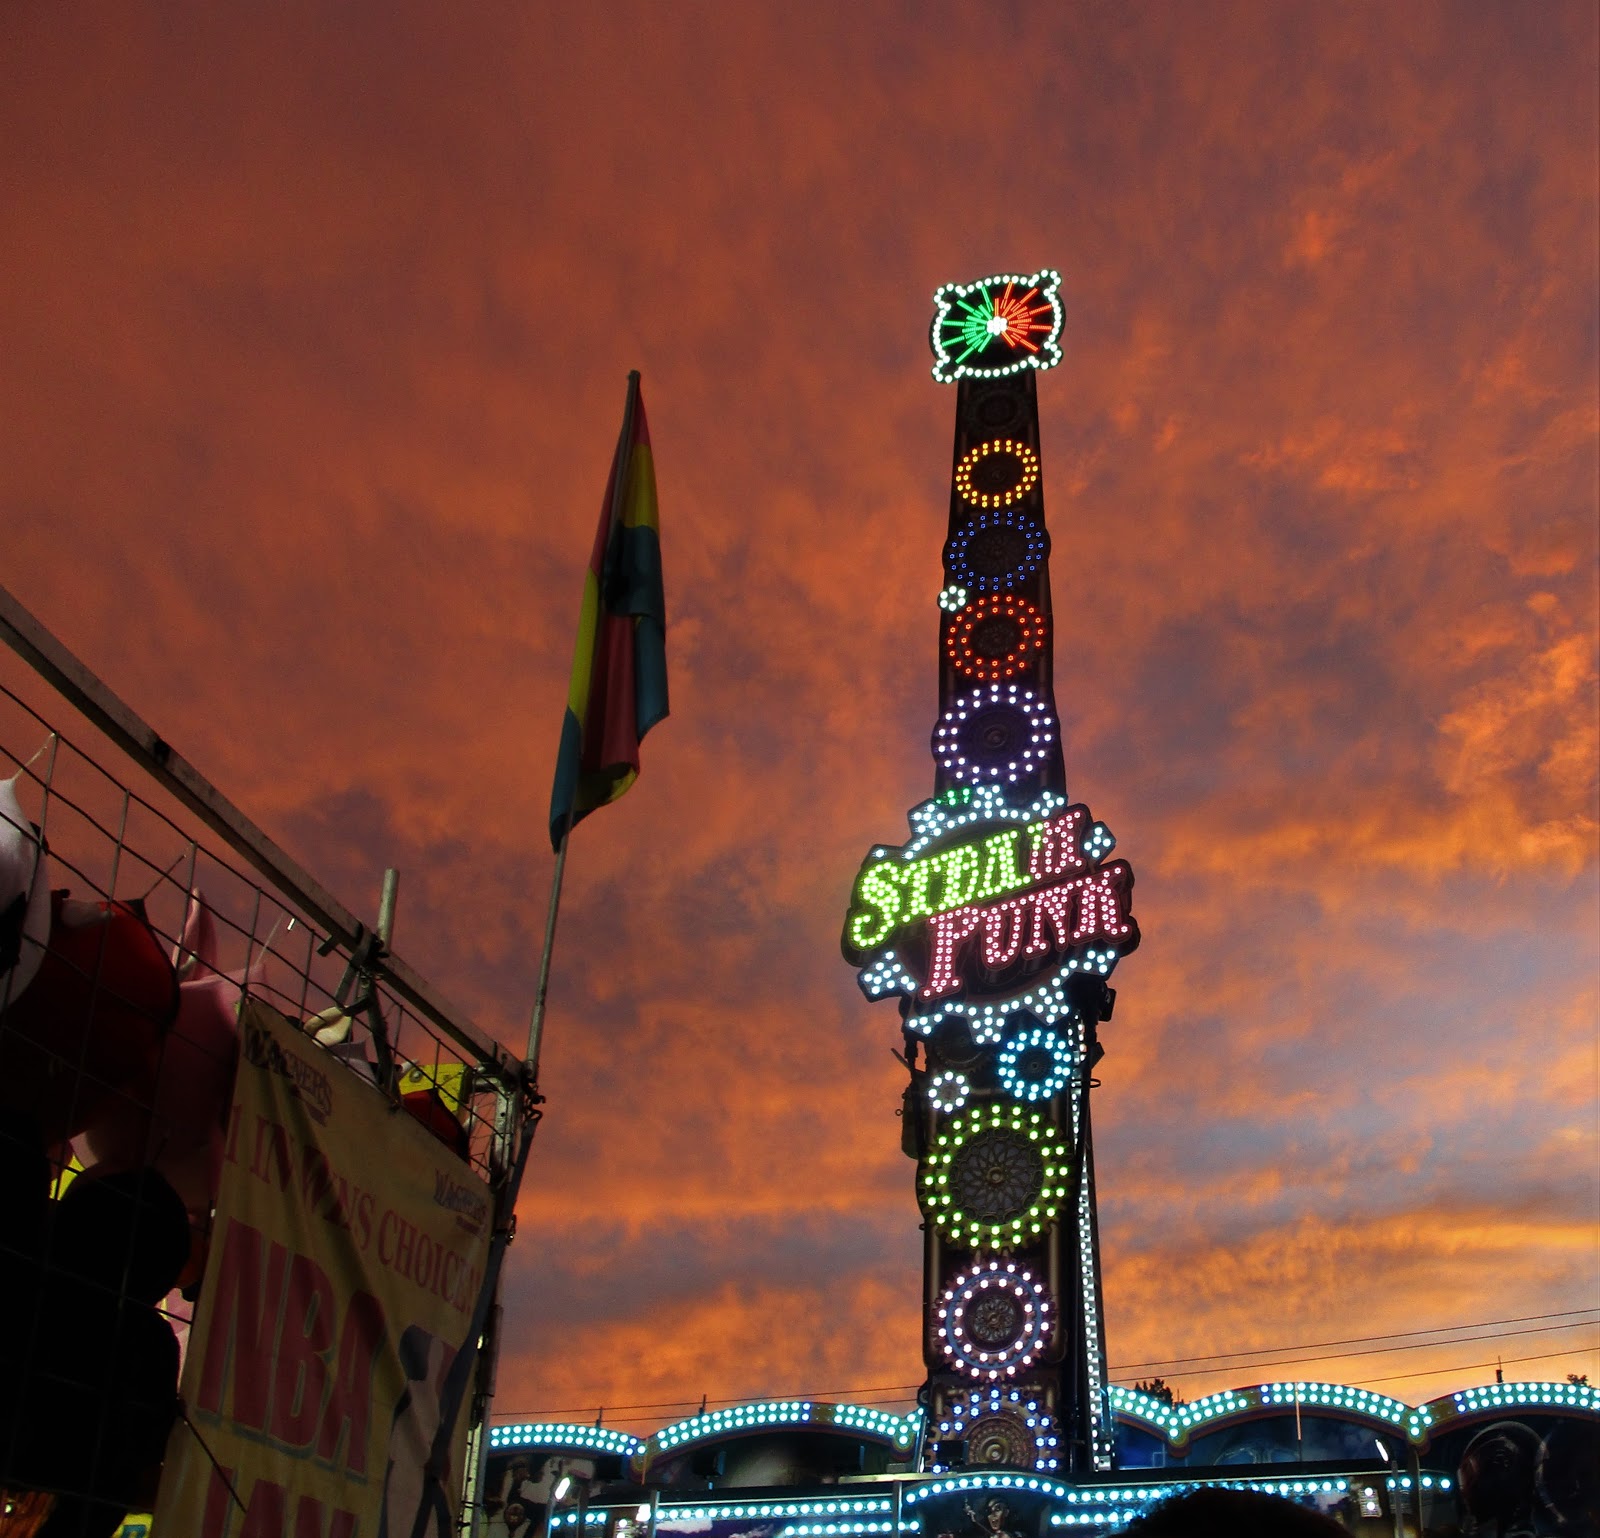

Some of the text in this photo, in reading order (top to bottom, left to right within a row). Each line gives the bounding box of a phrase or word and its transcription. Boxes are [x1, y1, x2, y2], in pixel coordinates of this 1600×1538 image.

[851, 809, 1083, 948] STEAM
[919, 864, 1133, 999] PUNK
[198, 1216, 387, 1484] NBA
